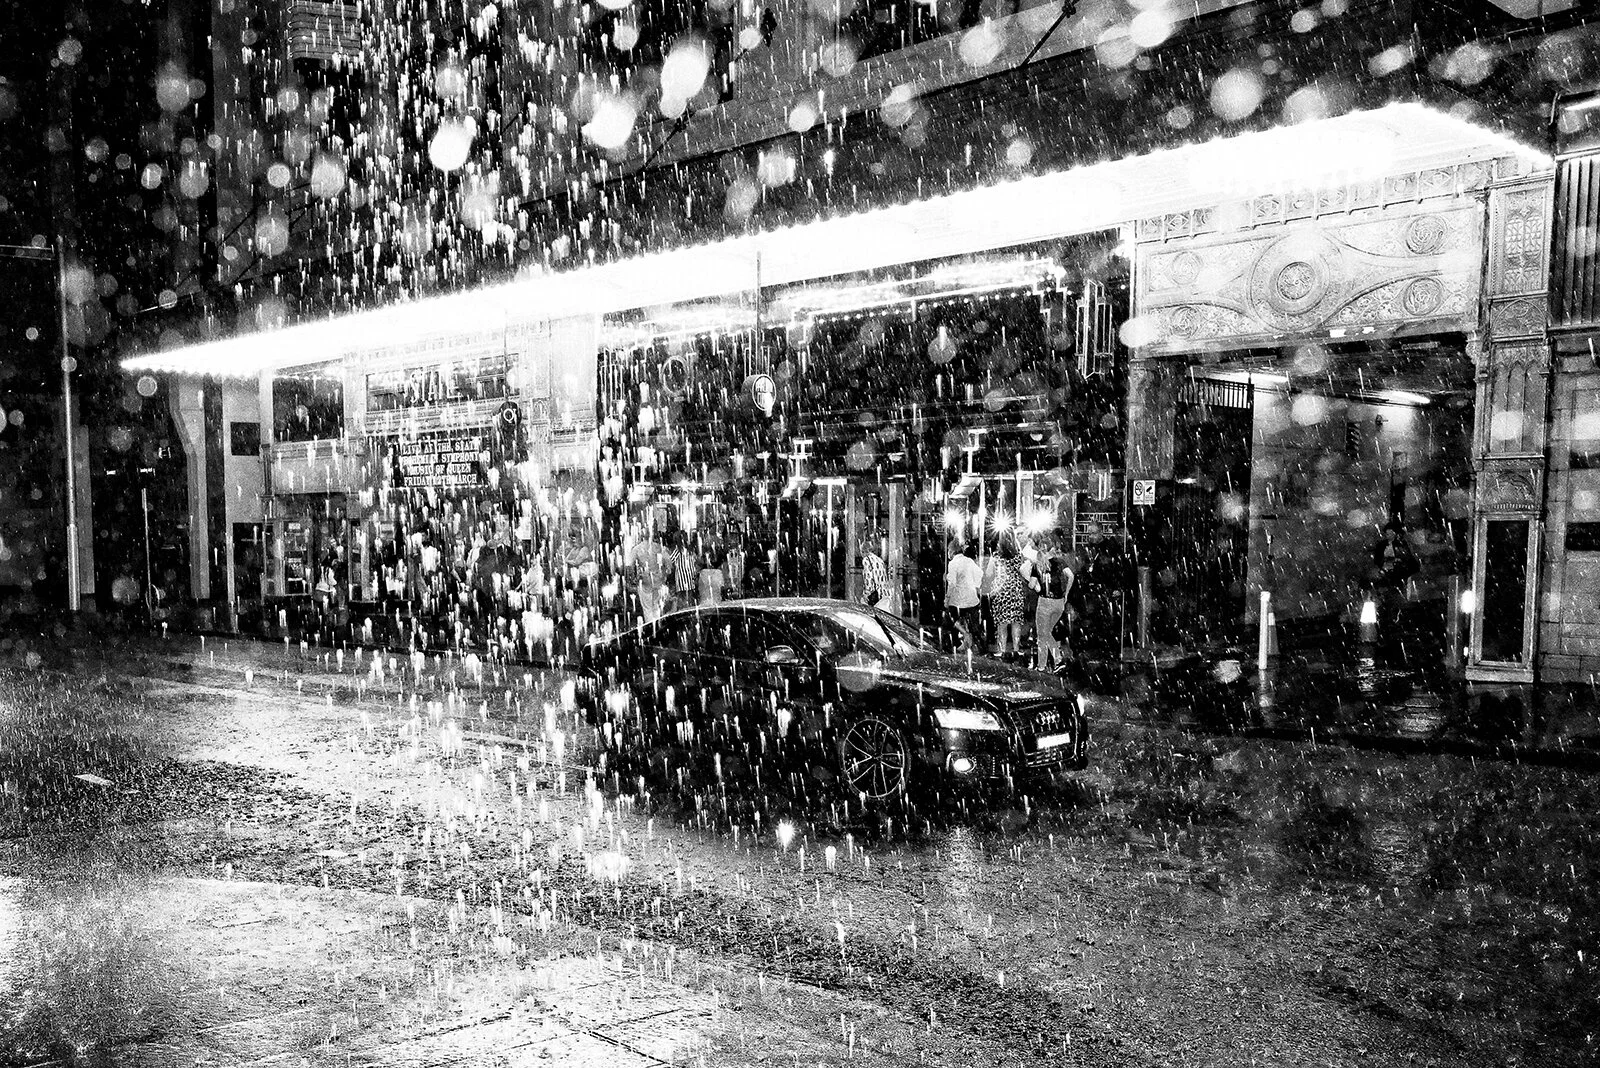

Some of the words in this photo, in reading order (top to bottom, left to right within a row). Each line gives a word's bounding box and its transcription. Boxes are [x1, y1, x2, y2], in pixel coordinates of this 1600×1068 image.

[441, 452, 480, 463] SYMPHONY
[436, 464, 445, 474] OF
[447, 463, 471, 474] QUEEN
[404, 476, 431, 486] FRIDAY
